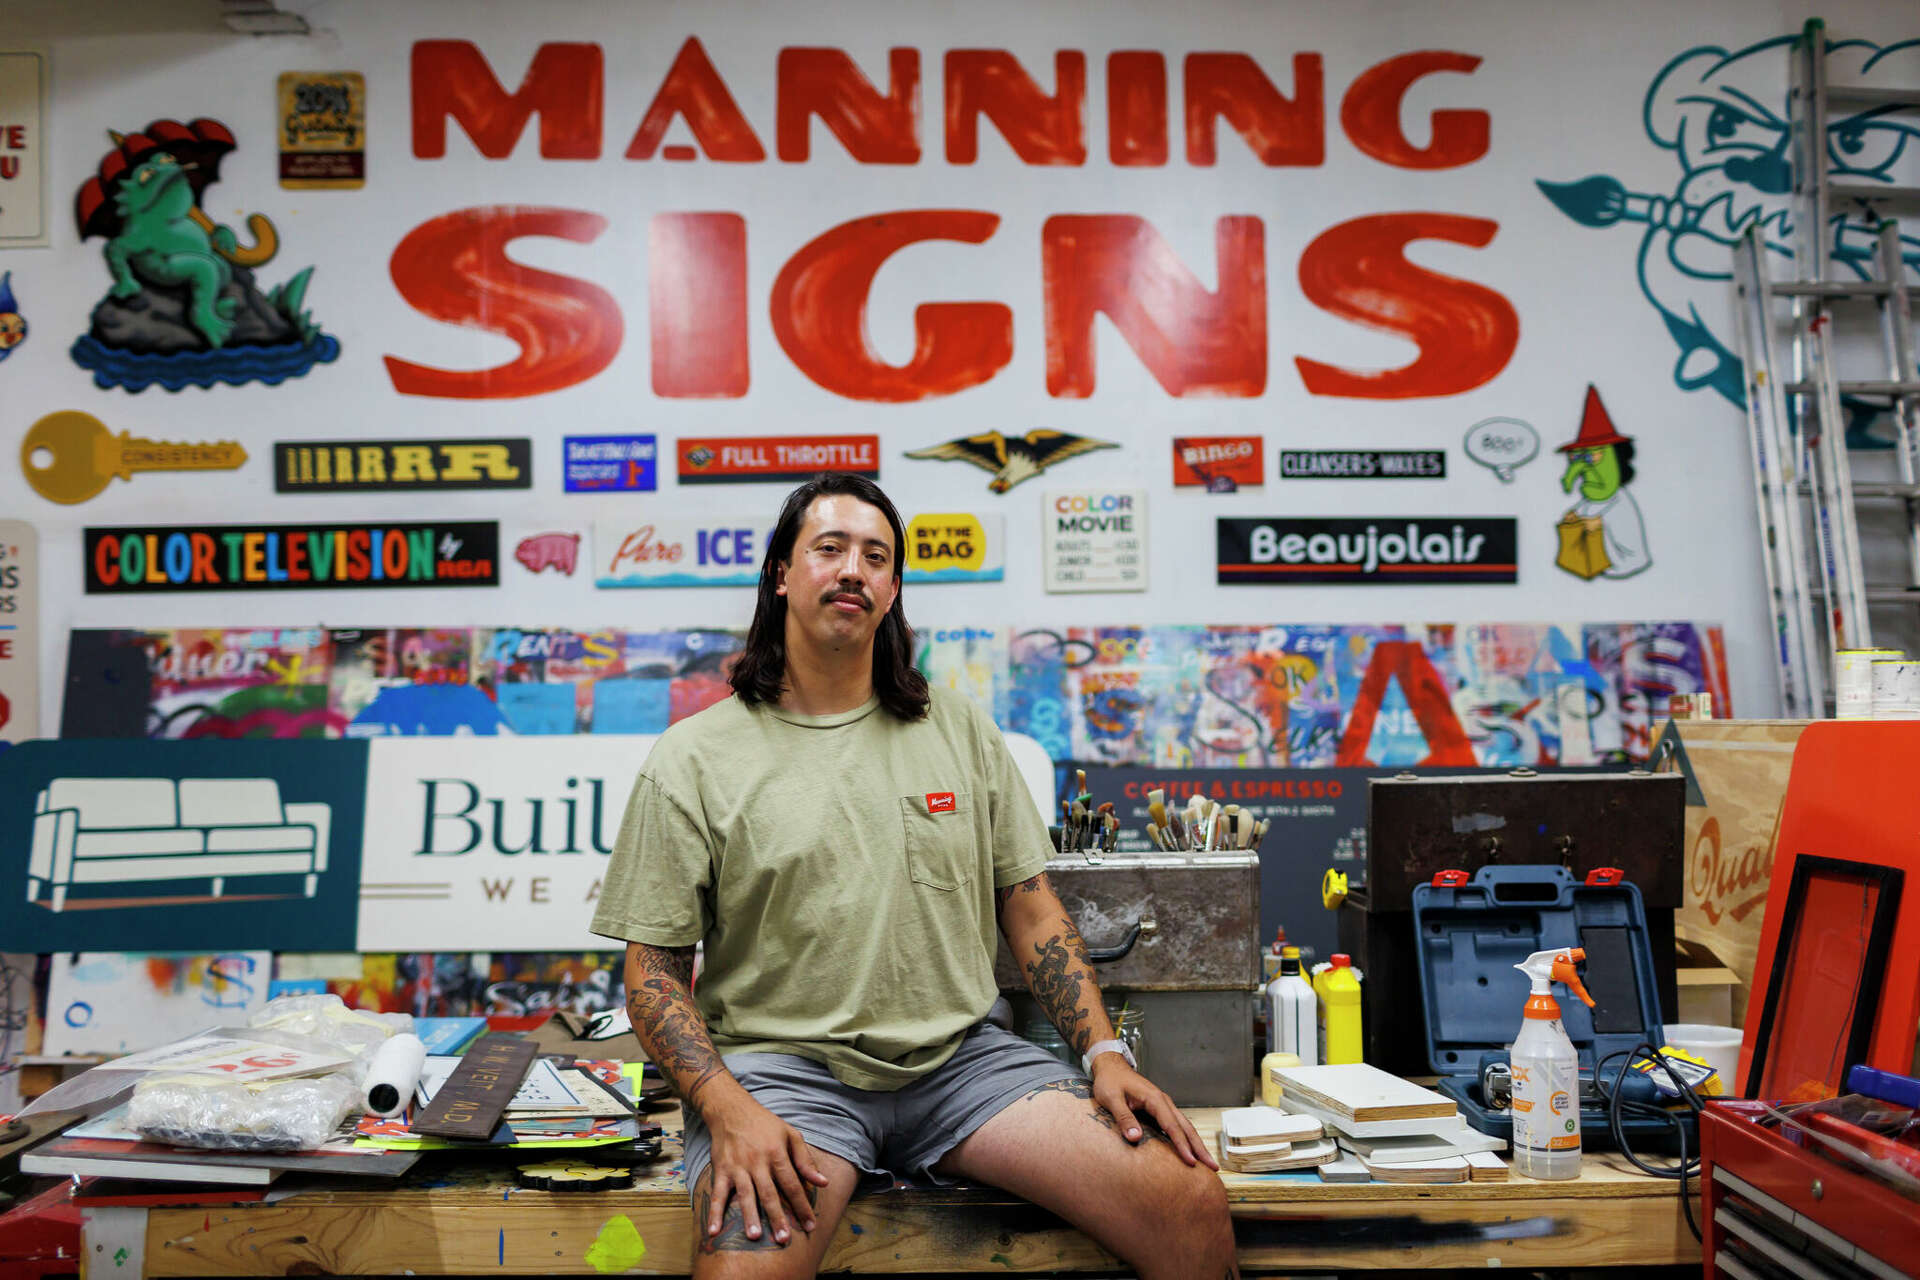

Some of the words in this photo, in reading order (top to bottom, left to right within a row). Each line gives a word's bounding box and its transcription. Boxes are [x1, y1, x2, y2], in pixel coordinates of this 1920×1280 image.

[411, 36, 1492, 170] MANNING
[383, 204, 1521, 401] SIGNS
[721, 446, 770, 468] FULL
[775, 443, 873, 466] THROTTLE
[1055, 495, 1135, 514] COLOR
[916, 527, 938, 538] BY
[945, 527, 971, 537] THE
[1056, 514, 1135, 533] MOVIE
[95, 532, 221, 585] COLOR
[221, 528, 435, 582] TELEVISION
[609, 523, 684, 574] Pure
[696, 528, 755, 566] ICE
[917, 542, 974, 559] BAG
[1250, 523, 1486, 573] Beaujolais
[1231, 780, 1343, 799] ESPRESSO
[481, 876, 551, 903] WE
